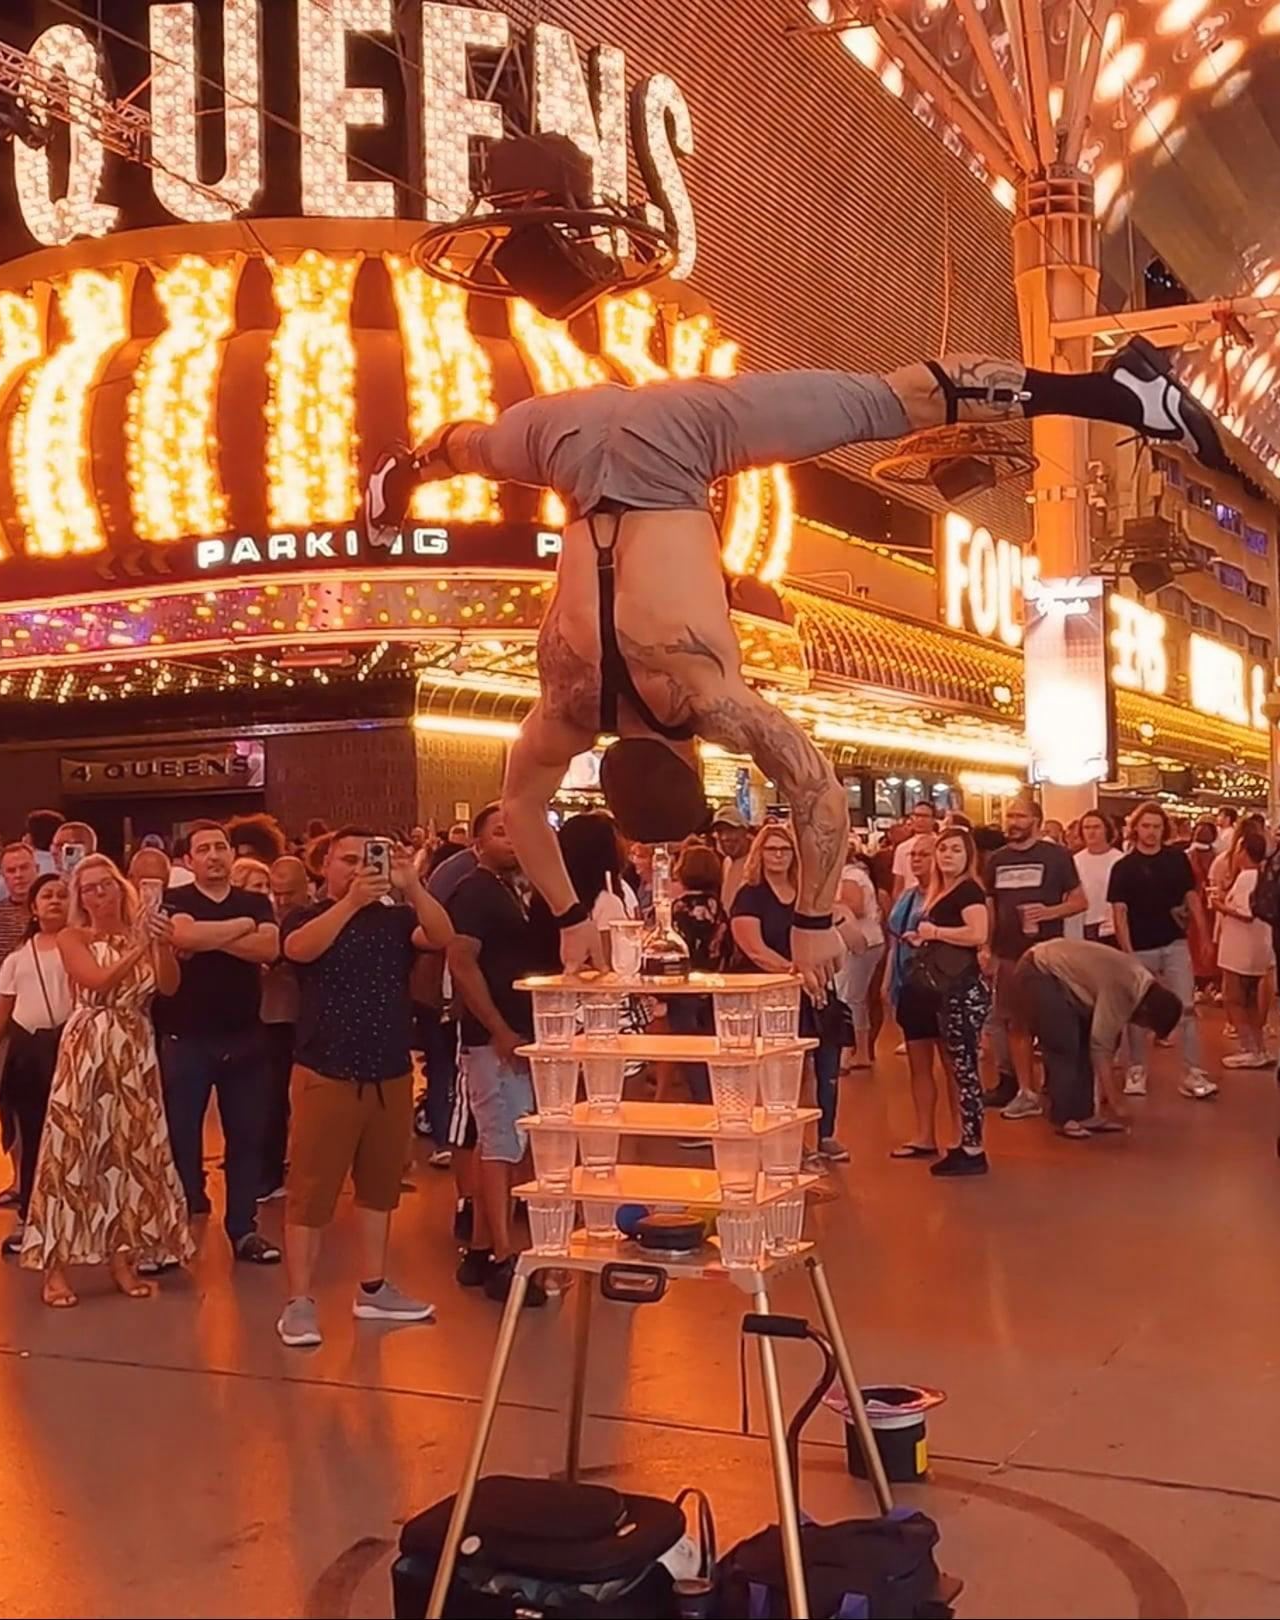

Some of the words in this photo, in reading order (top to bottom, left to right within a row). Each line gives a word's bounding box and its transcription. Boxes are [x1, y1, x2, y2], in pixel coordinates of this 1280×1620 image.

[13, 0, 697, 281] QUEENS
[196, 527, 449, 569] PARKIG
[70, 764, 92, 784] 4
[104, 756, 251, 781] QUEENS
